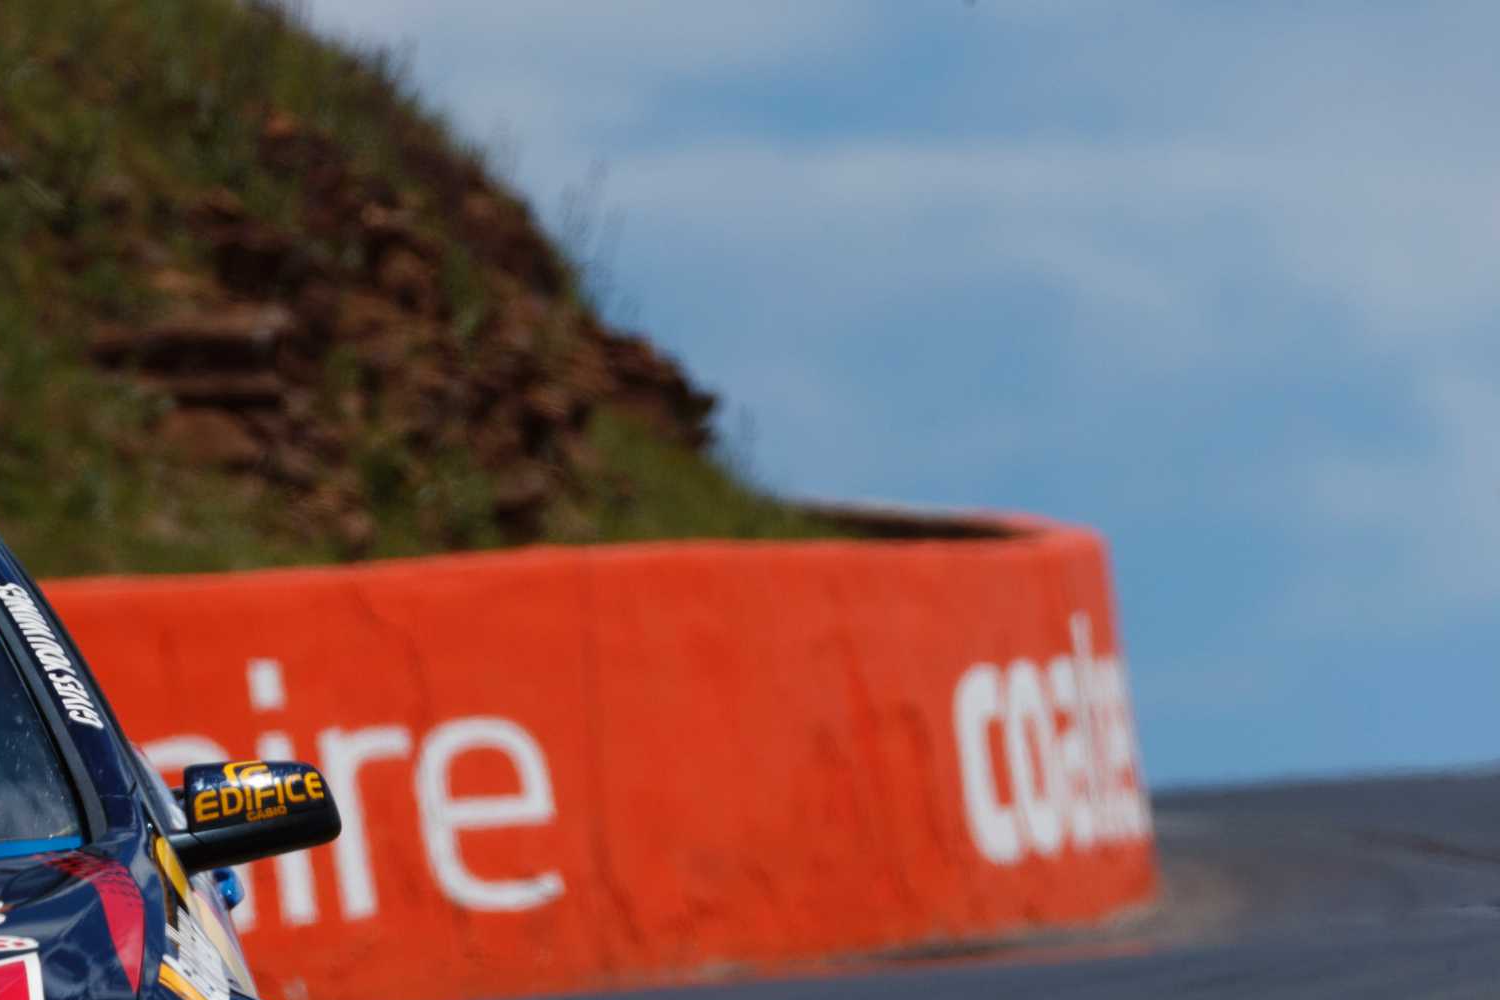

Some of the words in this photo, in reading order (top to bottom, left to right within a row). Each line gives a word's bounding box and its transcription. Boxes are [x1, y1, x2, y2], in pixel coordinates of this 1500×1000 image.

[26, 636, 78, 676] YOU
[47, 672, 105, 729] GIVES
[193, 771, 325, 823] EDIFICE
[246, 805, 288, 821] CASIO
